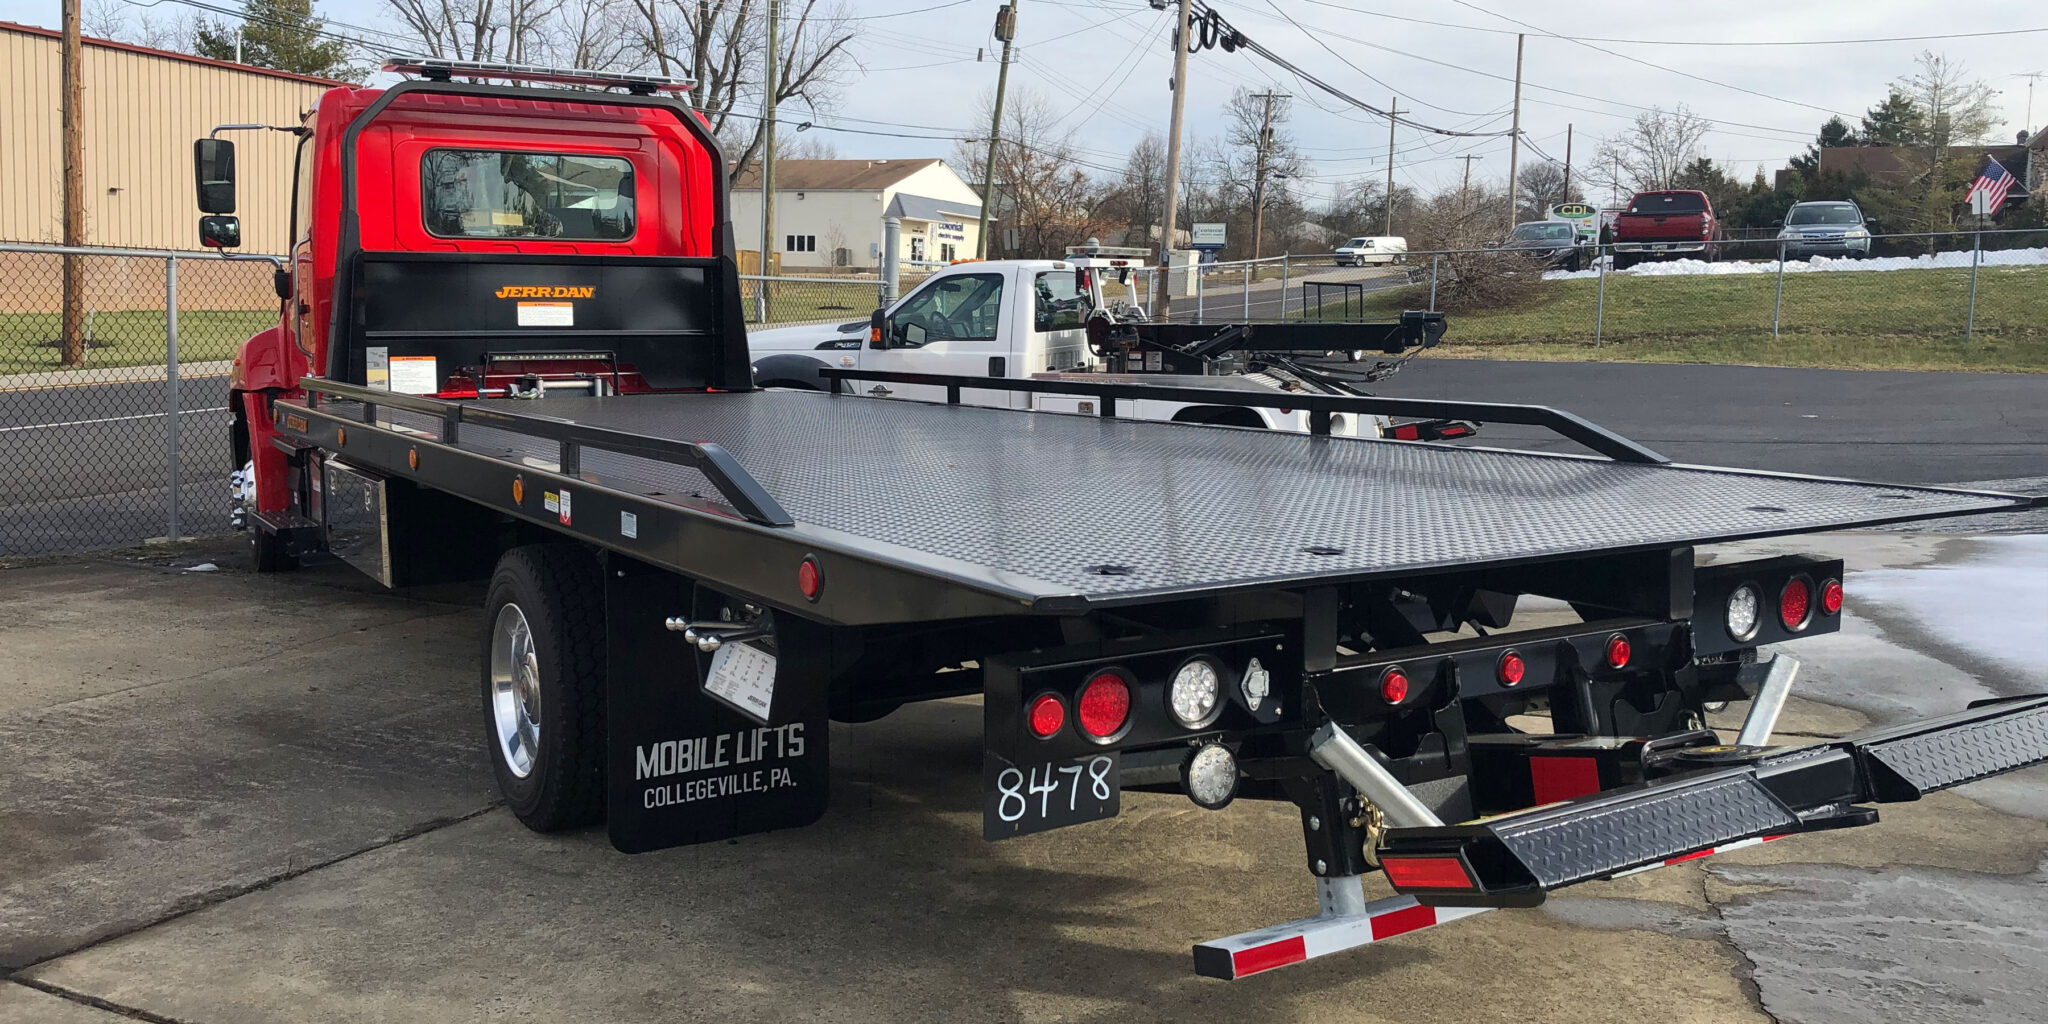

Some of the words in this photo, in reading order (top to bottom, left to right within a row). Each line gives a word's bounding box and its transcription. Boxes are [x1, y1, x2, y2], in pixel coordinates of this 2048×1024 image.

[938, 221, 963, 232] colonial
[1561, 205, 1587, 215] CDI
[636, 734, 731, 780] MOBILE
[736, 722, 804, 764] LIFTS
[644, 770, 768, 809] COLLEGEVILLE,
[771, 767, 797, 788] PA.
[997, 756, 1113, 822] 8478
